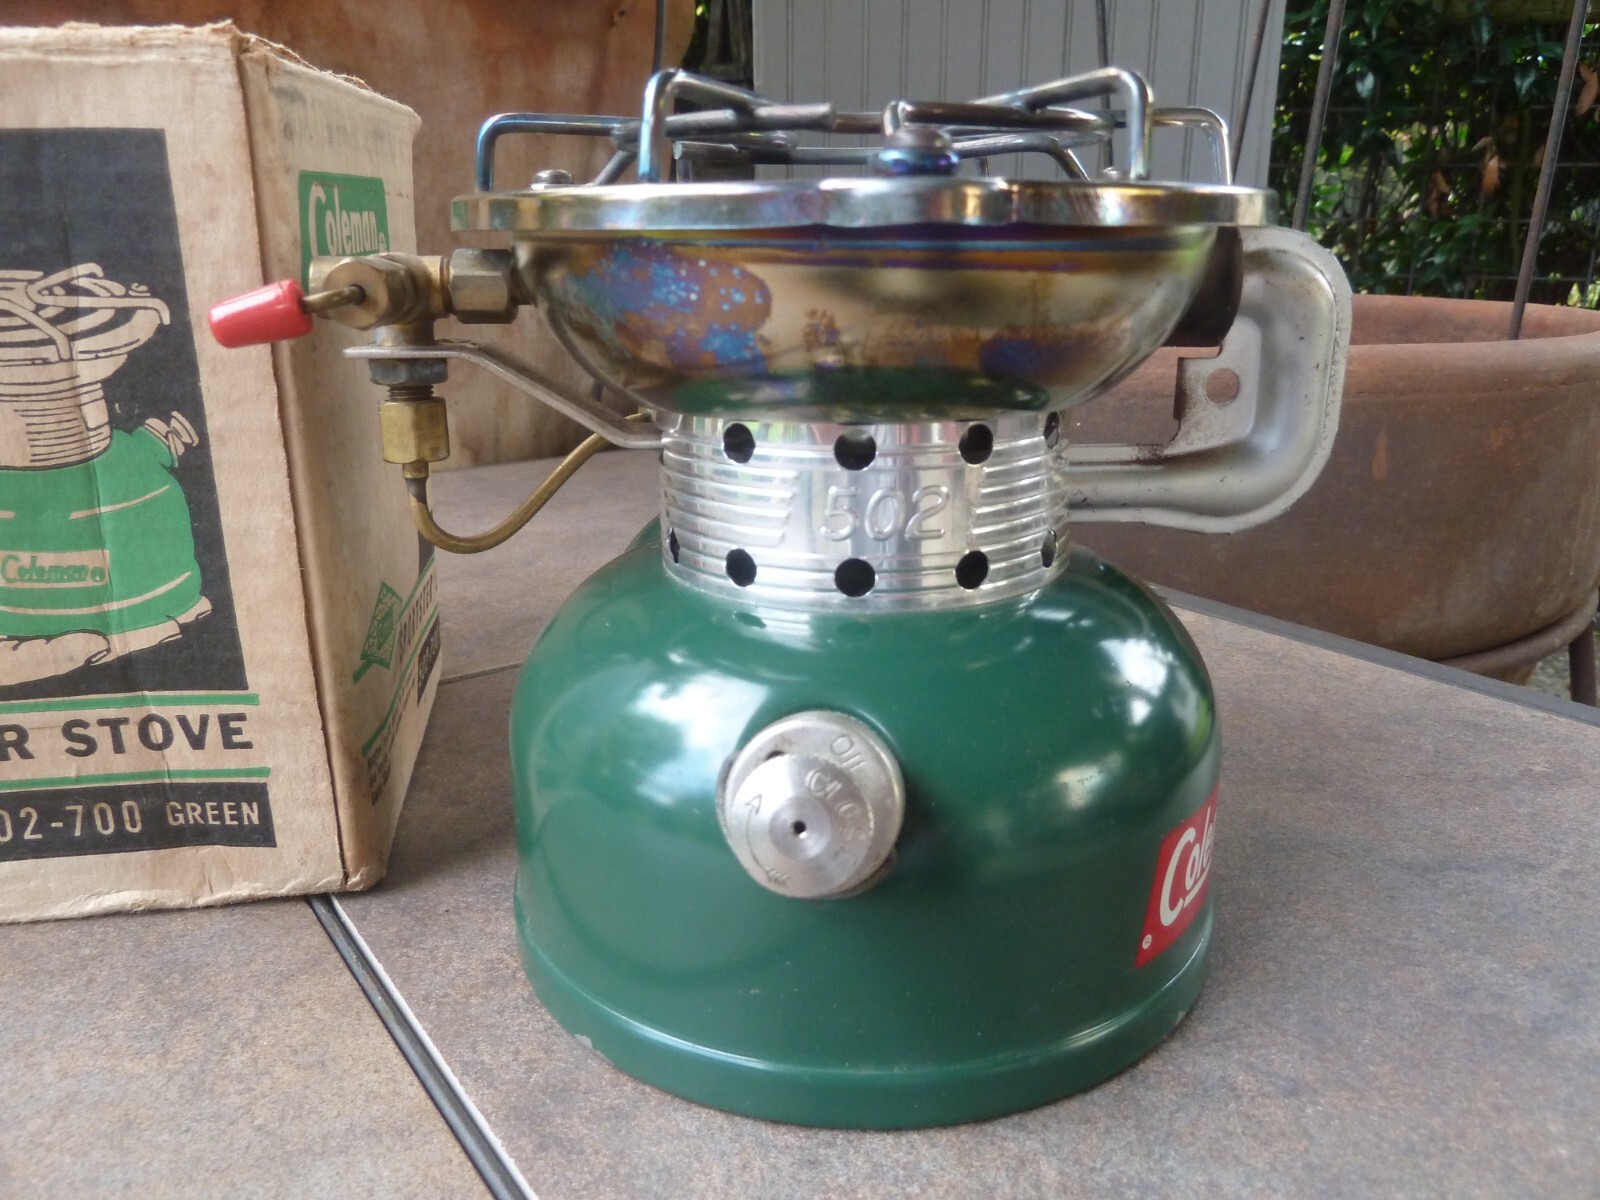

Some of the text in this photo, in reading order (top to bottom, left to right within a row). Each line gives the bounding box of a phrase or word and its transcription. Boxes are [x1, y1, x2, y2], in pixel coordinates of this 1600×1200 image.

[820, 484, 949, 541] 502
[61, 713, 253, 757] STOVE
[166, 801, 260, 826] GREEN
